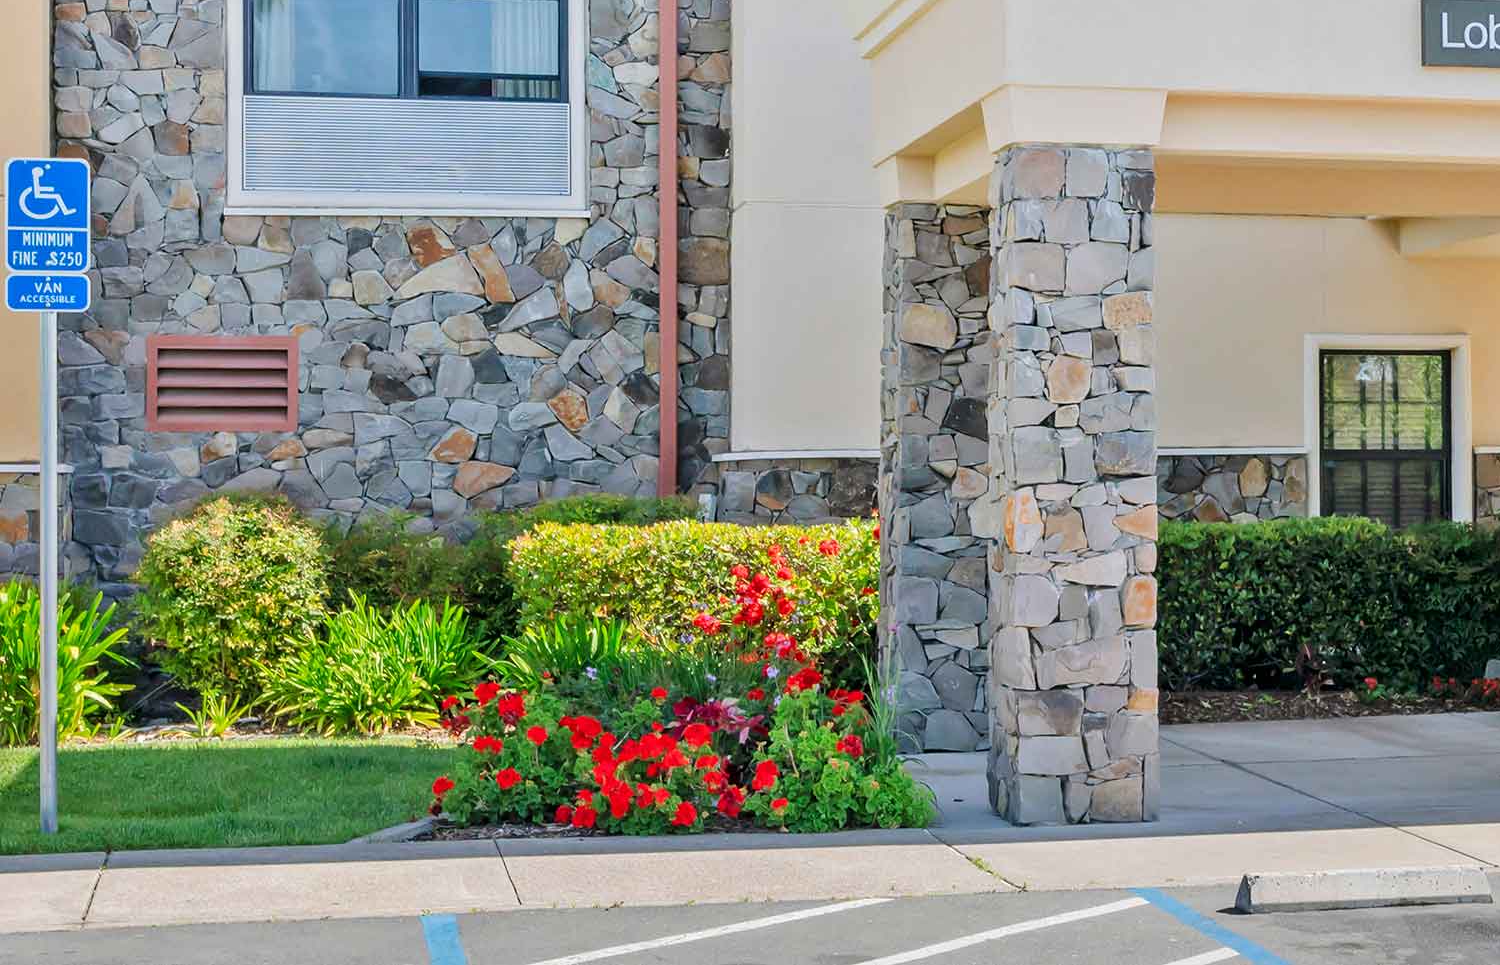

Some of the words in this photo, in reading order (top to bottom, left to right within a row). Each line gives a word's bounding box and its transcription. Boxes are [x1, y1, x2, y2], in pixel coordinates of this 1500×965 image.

[22, 232, 73, 247] MINIMUM
[12, 251, 38, 266] FINE
[34, 282, 63, 294] VAN
[19, 294, 77, 304] ACCESSIBLE
